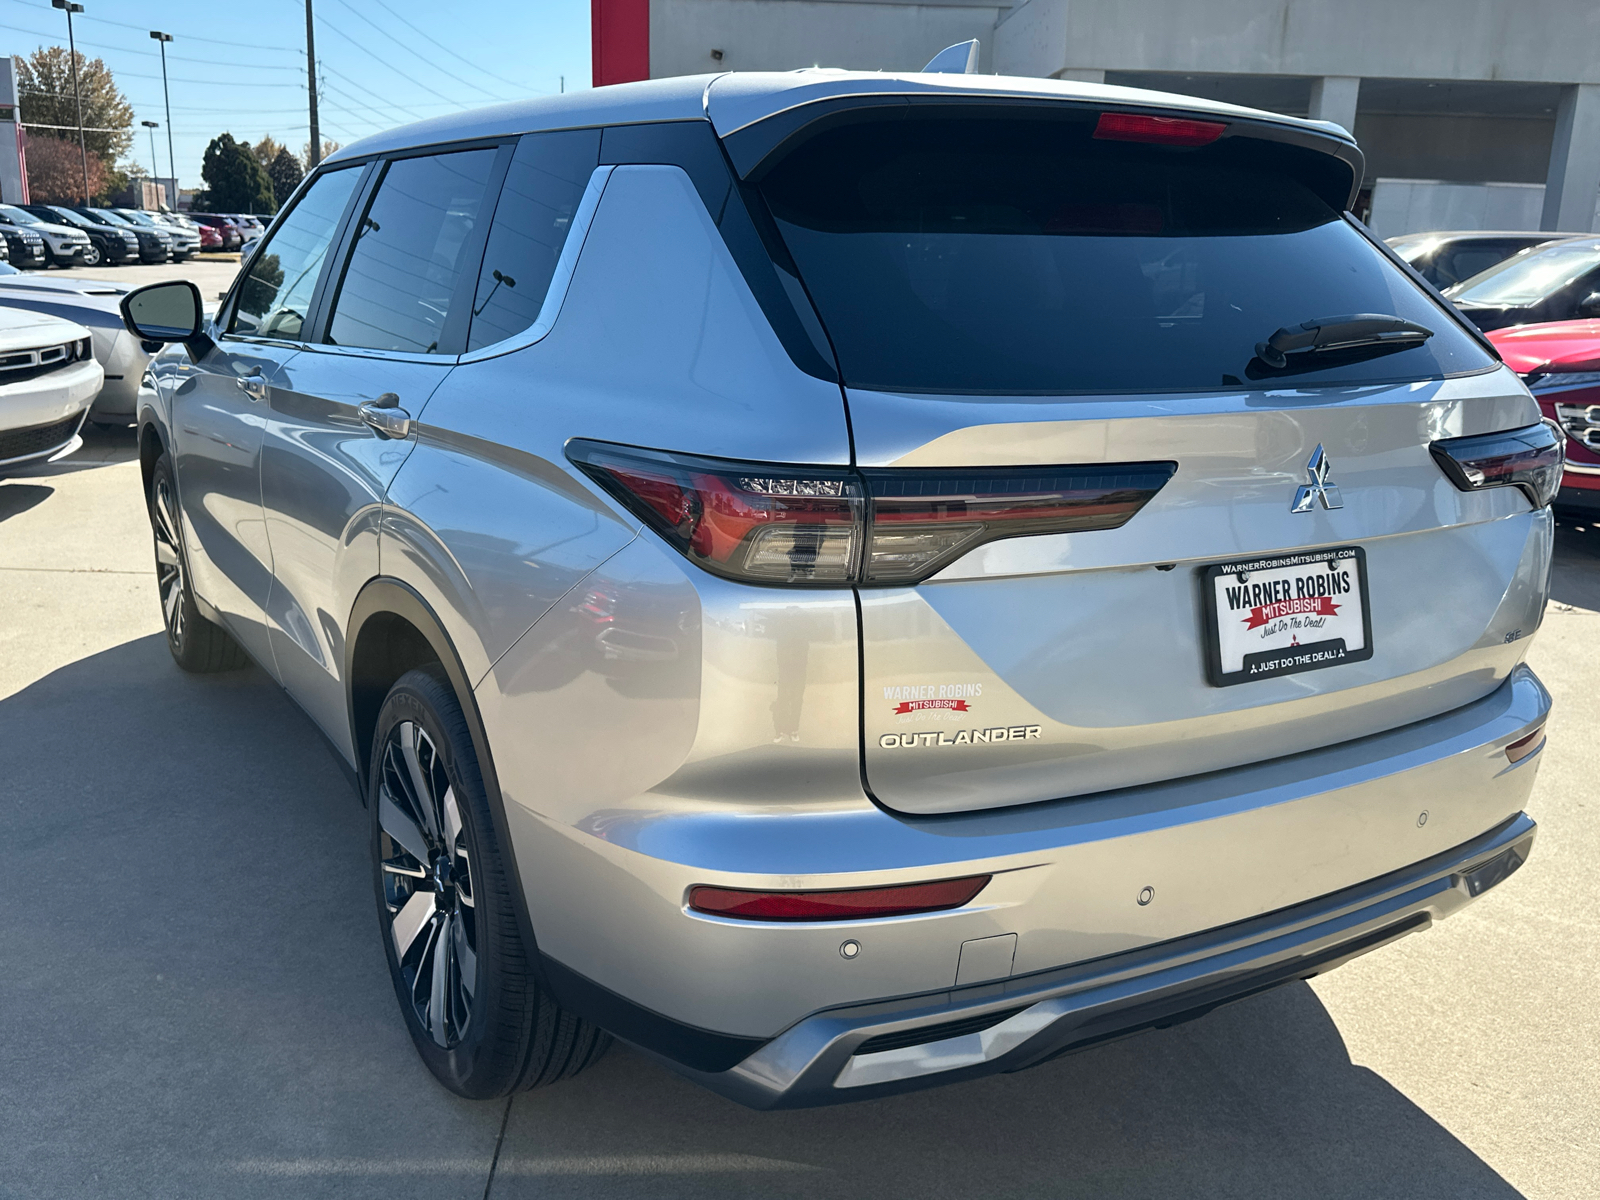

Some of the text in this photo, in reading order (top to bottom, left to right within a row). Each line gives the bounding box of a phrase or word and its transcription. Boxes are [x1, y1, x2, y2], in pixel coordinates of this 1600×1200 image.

[1225, 571, 1351, 610] WARNER ROBINS
[1262, 599, 1322, 620] MITSUBISHI
[1260, 616, 1326, 639] Just Do The Deal!
[1258, 650, 1337, 672] JUST DO THE DEAL!
[883, 683, 983, 700] WARNER ROBINS
[908, 700, 958, 711] MITSUBISHI
[879, 724, 1042, 749] OUTLANDER
